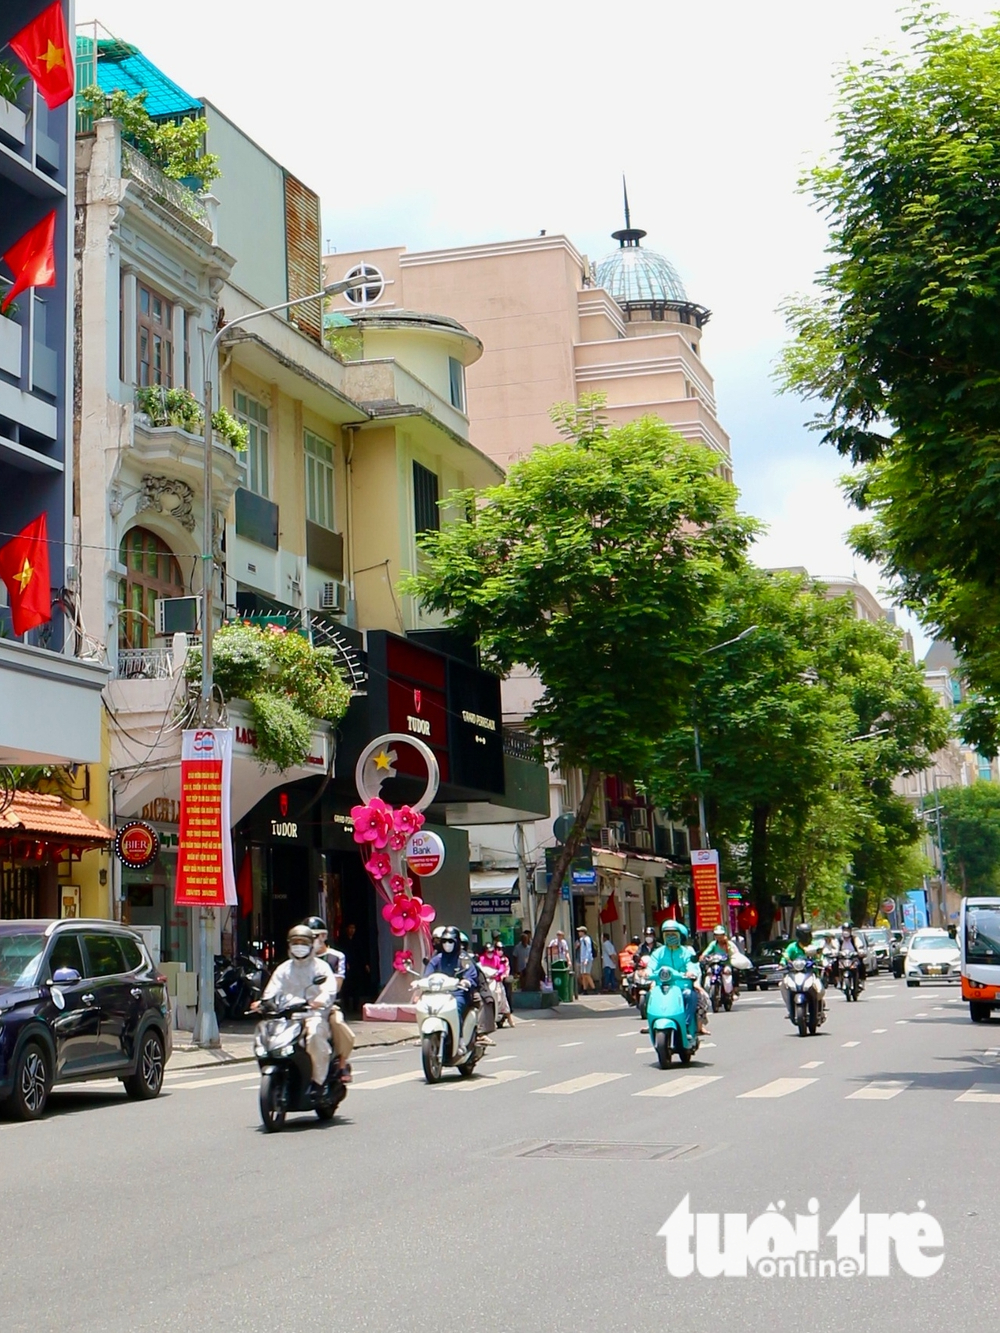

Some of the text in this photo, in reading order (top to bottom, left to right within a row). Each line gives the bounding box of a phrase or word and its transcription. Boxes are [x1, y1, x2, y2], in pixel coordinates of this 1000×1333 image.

[406, 715, 431, 736] TUDOR
[271, 820, 298, 838] TUDOR
[125, 840, 148, 849] BIER
[412, 838, 423, 846] HD
[412, 847, 431, 855] Bank
